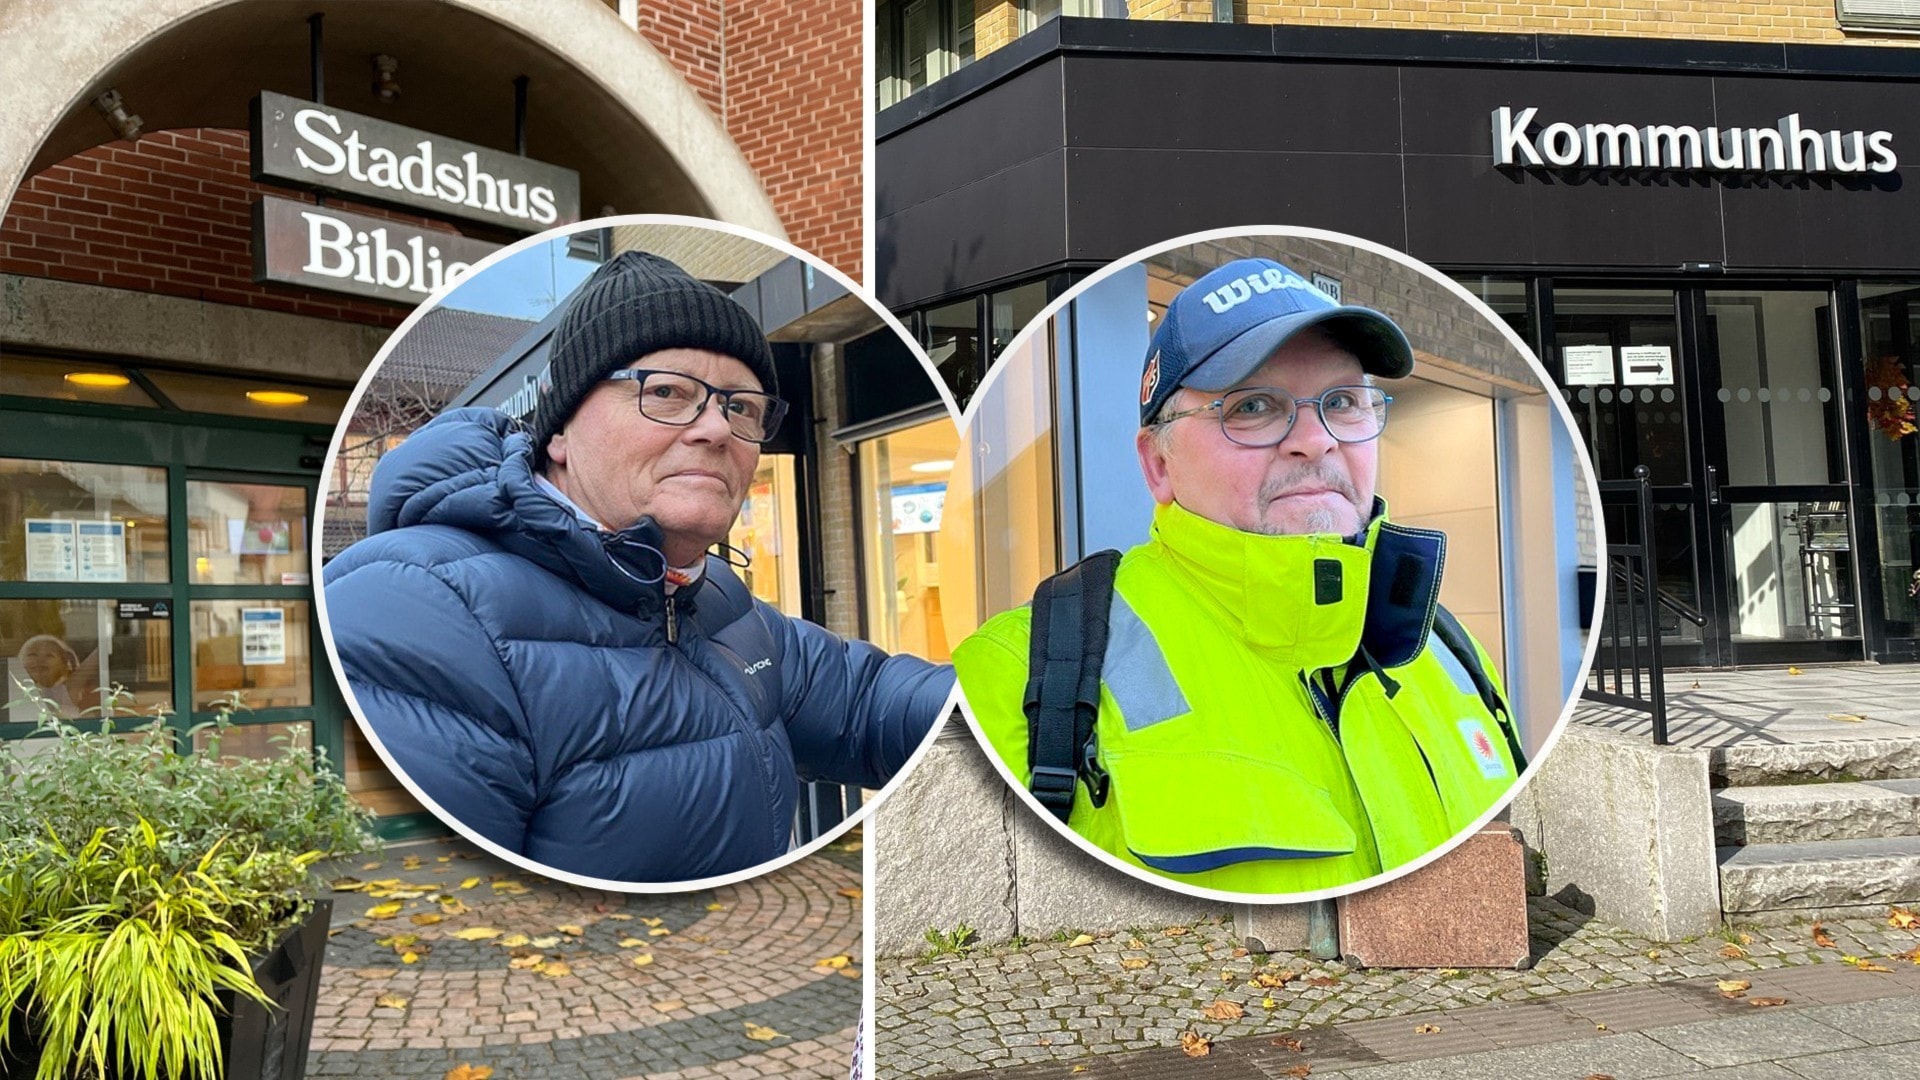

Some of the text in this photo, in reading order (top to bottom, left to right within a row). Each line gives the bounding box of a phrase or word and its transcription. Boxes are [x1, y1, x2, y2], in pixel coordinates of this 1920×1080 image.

[293, 108, 558, 225] Stadshus
[1491, 105, 1899, 174] Kommunhus
[1202, 268, 1342, 314] Wils
